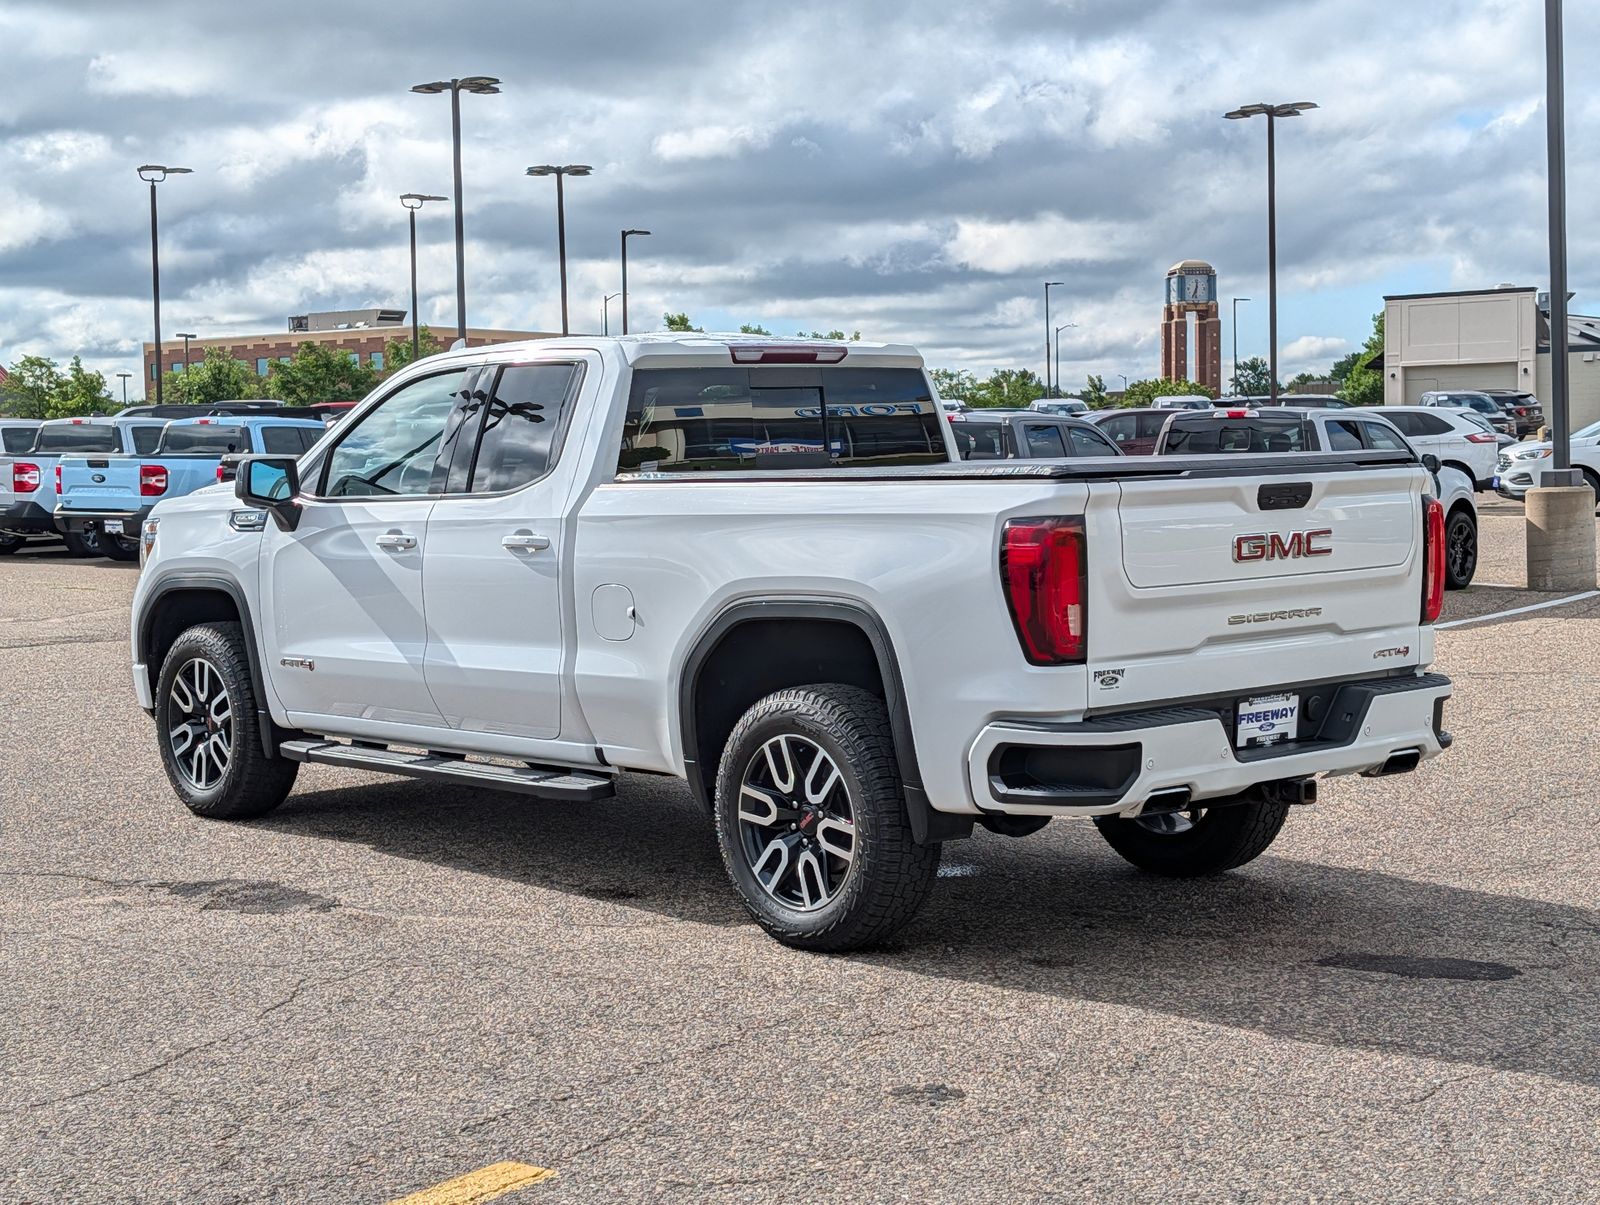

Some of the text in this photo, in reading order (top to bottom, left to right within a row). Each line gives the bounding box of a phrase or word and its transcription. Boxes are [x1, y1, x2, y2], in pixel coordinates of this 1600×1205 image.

[1232, 528, 1332, 563] GMC
[1228, 607, 1322, 625] SIERRA
[1373, 646, 1410, 659] AT4
[1093, 668, 1126, 682] FREEWAY
[1237, 706, 1296, 725] FREEWAY
